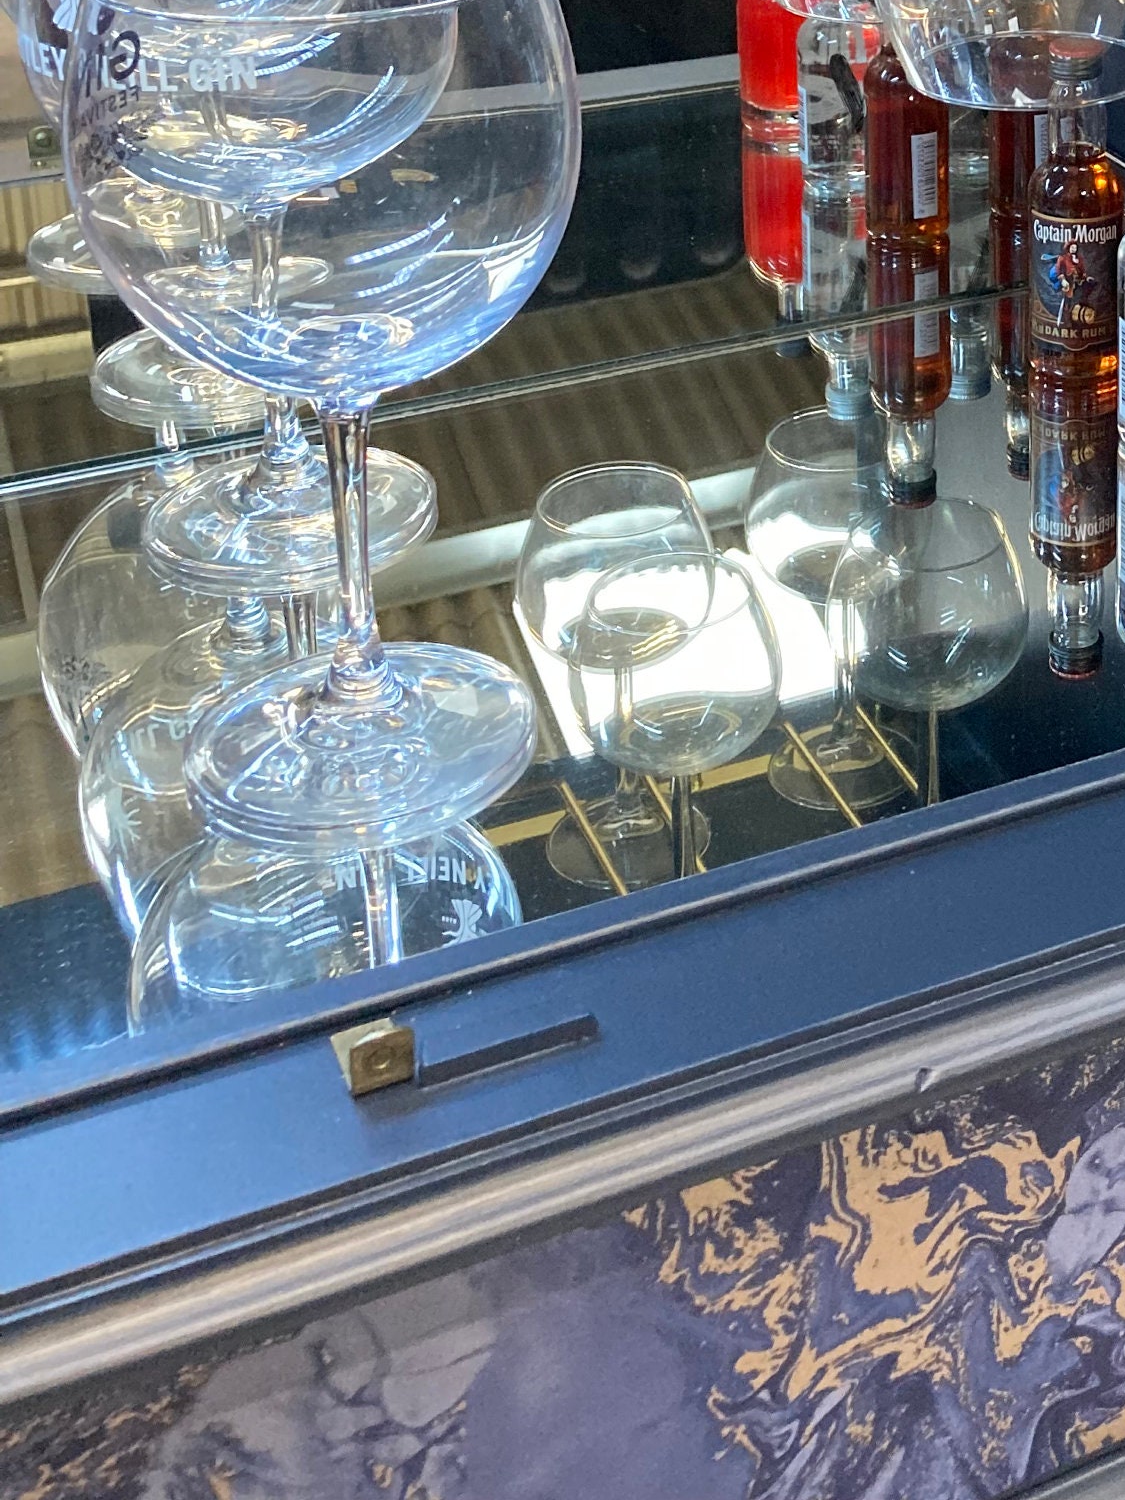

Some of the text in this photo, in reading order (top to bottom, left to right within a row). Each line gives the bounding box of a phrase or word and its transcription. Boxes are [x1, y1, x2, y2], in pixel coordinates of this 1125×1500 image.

[187, 55, 258, 93] GIN
[1033, 219, 1118, 244] Captain Morgan
[1044, 325, 1078, 339] DARK
[1082, 326, 1107, 338] RUM
